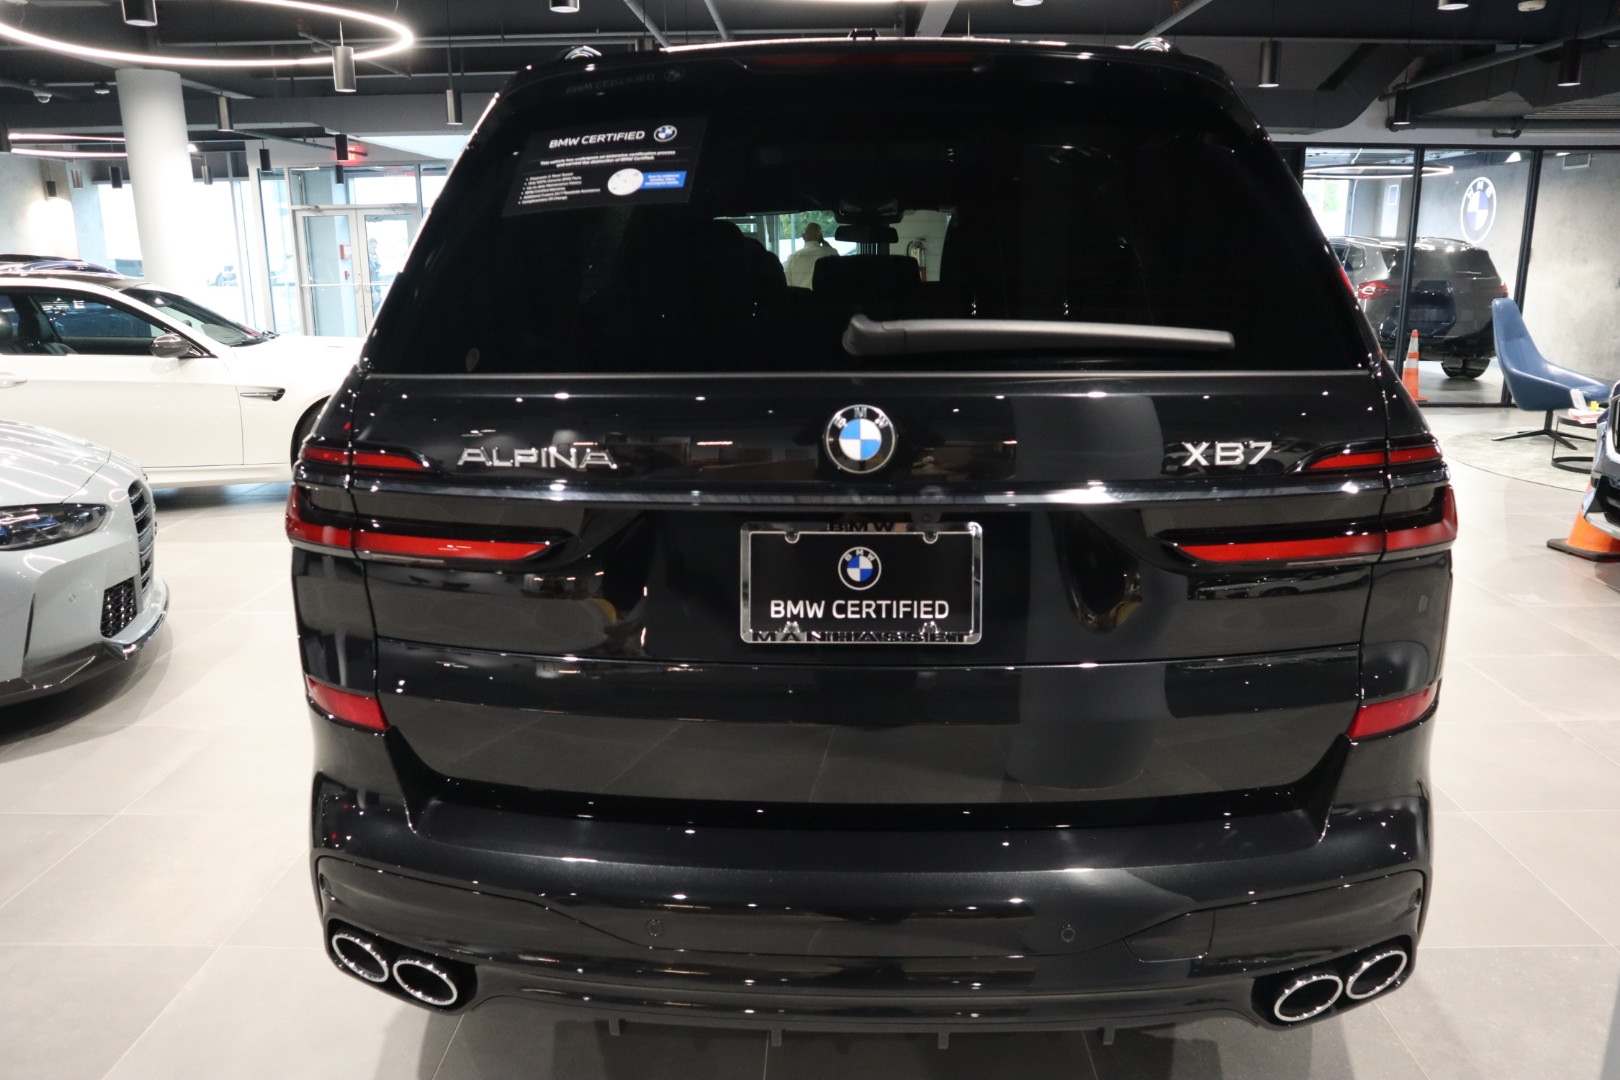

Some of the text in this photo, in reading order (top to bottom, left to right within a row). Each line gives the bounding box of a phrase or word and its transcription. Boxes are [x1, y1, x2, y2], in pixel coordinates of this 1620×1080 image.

[549, 130, 646, 149] BMW CERTIFIED
[457, 447, 618, 469] ALPINA
[1181, 440, 1272, 466] XB7
[770, 600, 950, 619] BMW CERTIFIED
